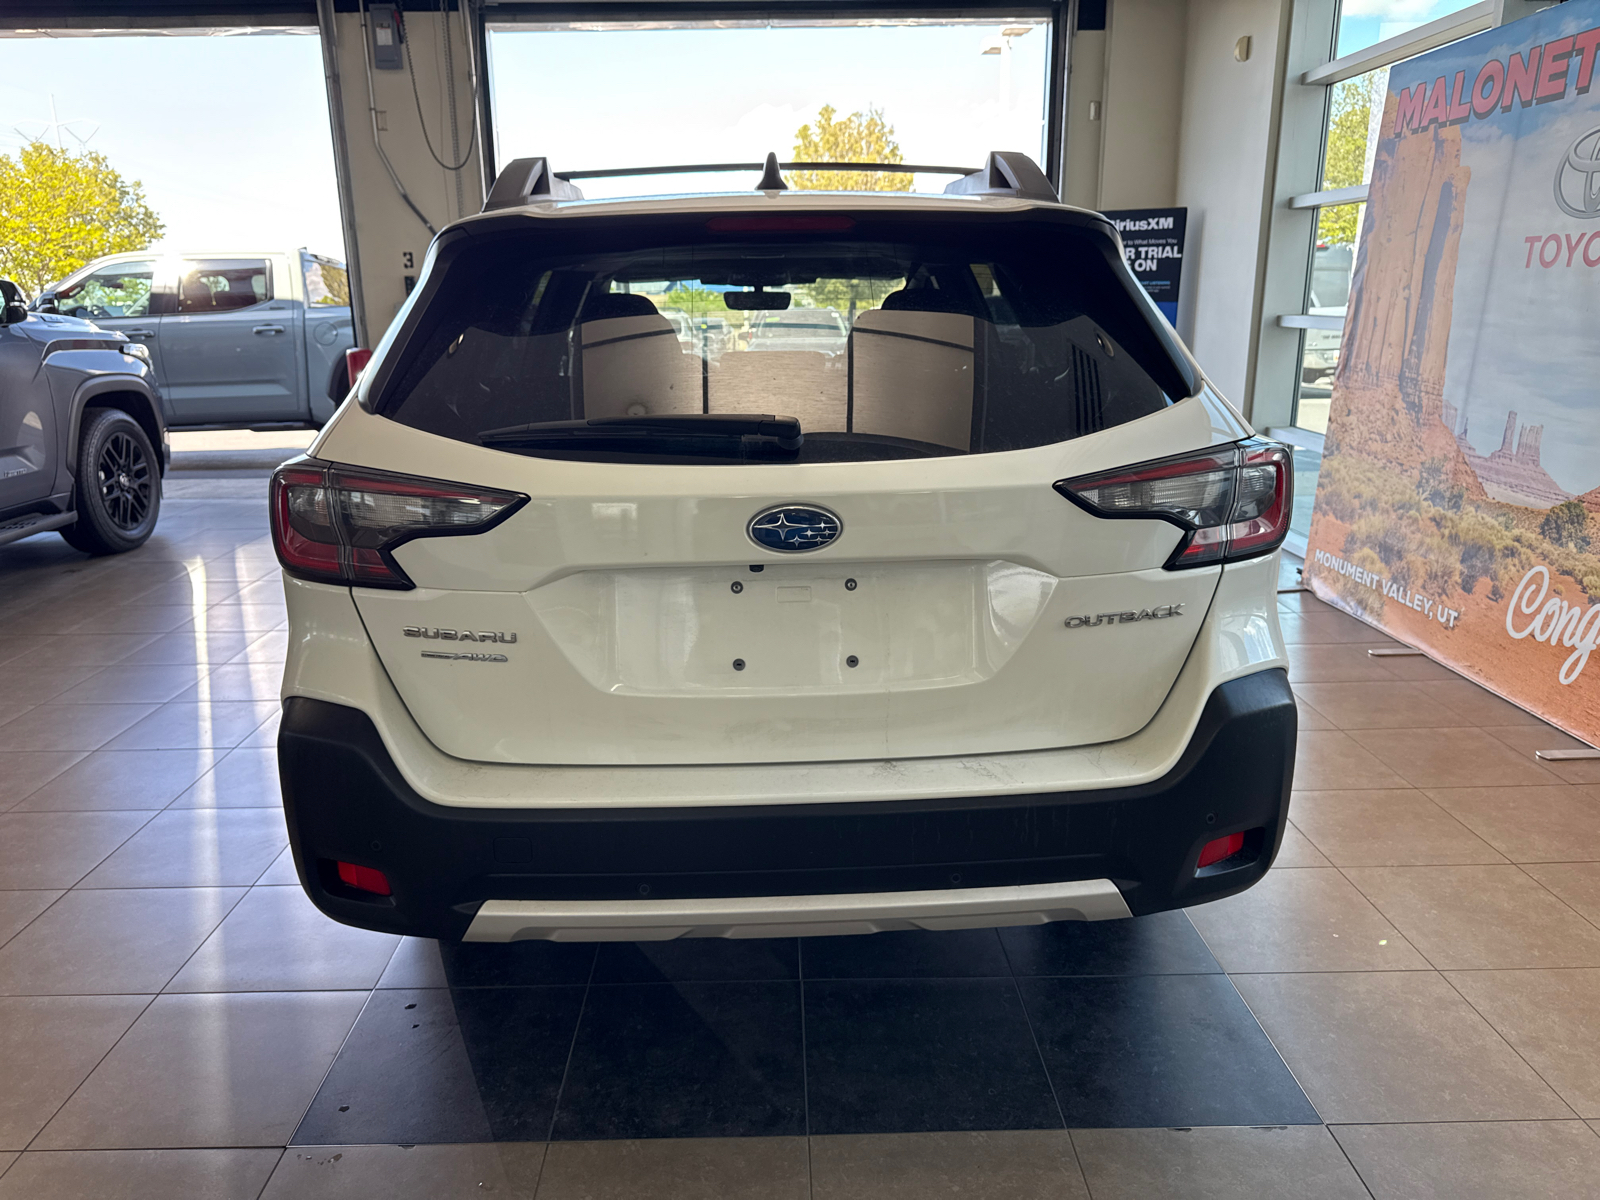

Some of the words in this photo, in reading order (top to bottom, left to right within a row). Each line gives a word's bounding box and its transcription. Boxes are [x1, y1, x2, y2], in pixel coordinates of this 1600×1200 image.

[403, 252, 413, 268] 3
[1138, 246, 1182, 259] TRIAL
[1134, 259, 1157, 271] ON
[1314, 548, 1380, 590] MONUMENT
[1381, 577, 1434, 621] VALLEY,
[1436, 604, 1459, 628] UT
[1064, 602, 1186, 629] OUTBACK
[403, 625, 518, 644] SUBARU
[453, 653, 508, 662] AWD
